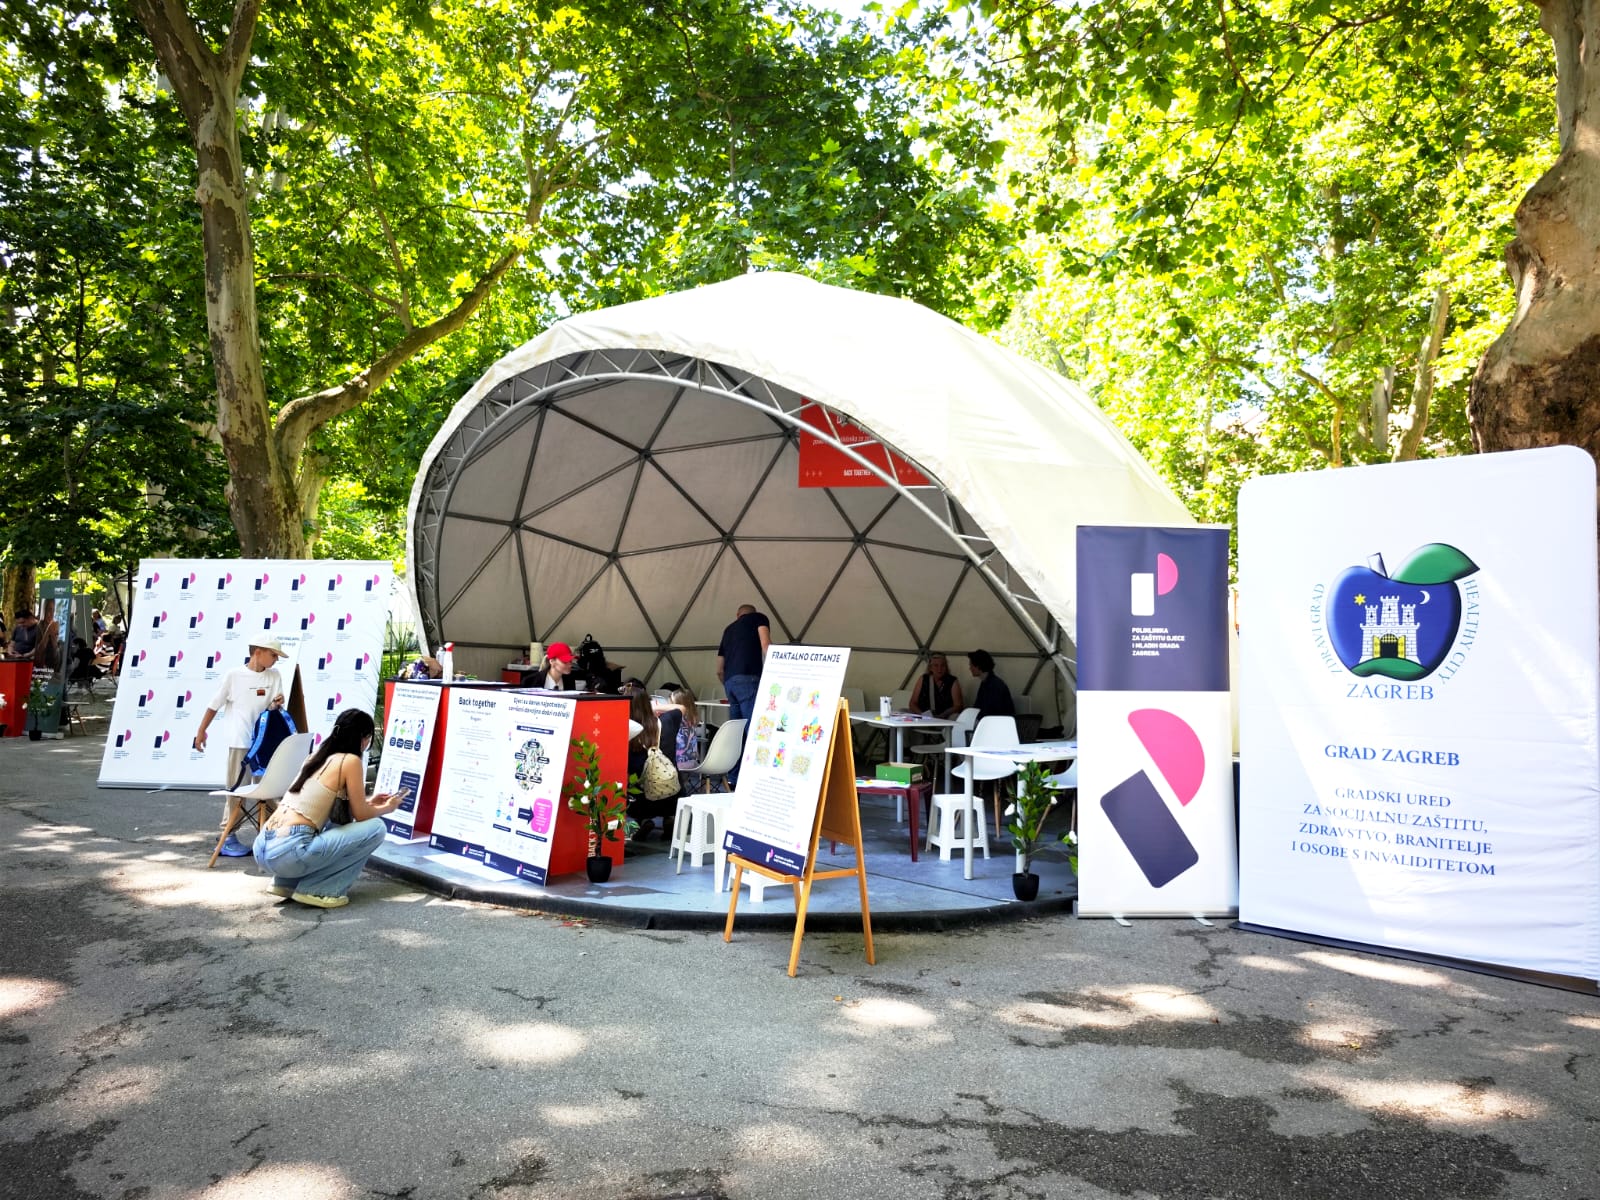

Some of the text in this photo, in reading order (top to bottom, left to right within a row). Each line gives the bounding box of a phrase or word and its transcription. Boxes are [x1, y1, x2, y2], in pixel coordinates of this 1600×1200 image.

[1310, 583, 1325, 624] GRAD
[1459, 579, 1480, 651] HEALTHY
[772, 651, 840, 663] FRAKTALNO CRTANJE
[1312, 628, 1343, 674] ZDRAVI
[1438, 652, 1466, 685] CITY
[458, 696, 496, 708] Back together
[1346, 684, 1434, 700] ZAGREB
[1324, 744, 1460, 766] GRAD ZAGREB
[1335, 787, 1451, 808] GRADSKI URED
[1303, 804, 1488, 834] ZA SOCIJALNU ZAŠTITU,
[1299, 822, 1492, 855] ZDRAVSTVO, BRANITELJE
[1292, 841, 1496, 876] I OSOBE S INVALIDITETOM
